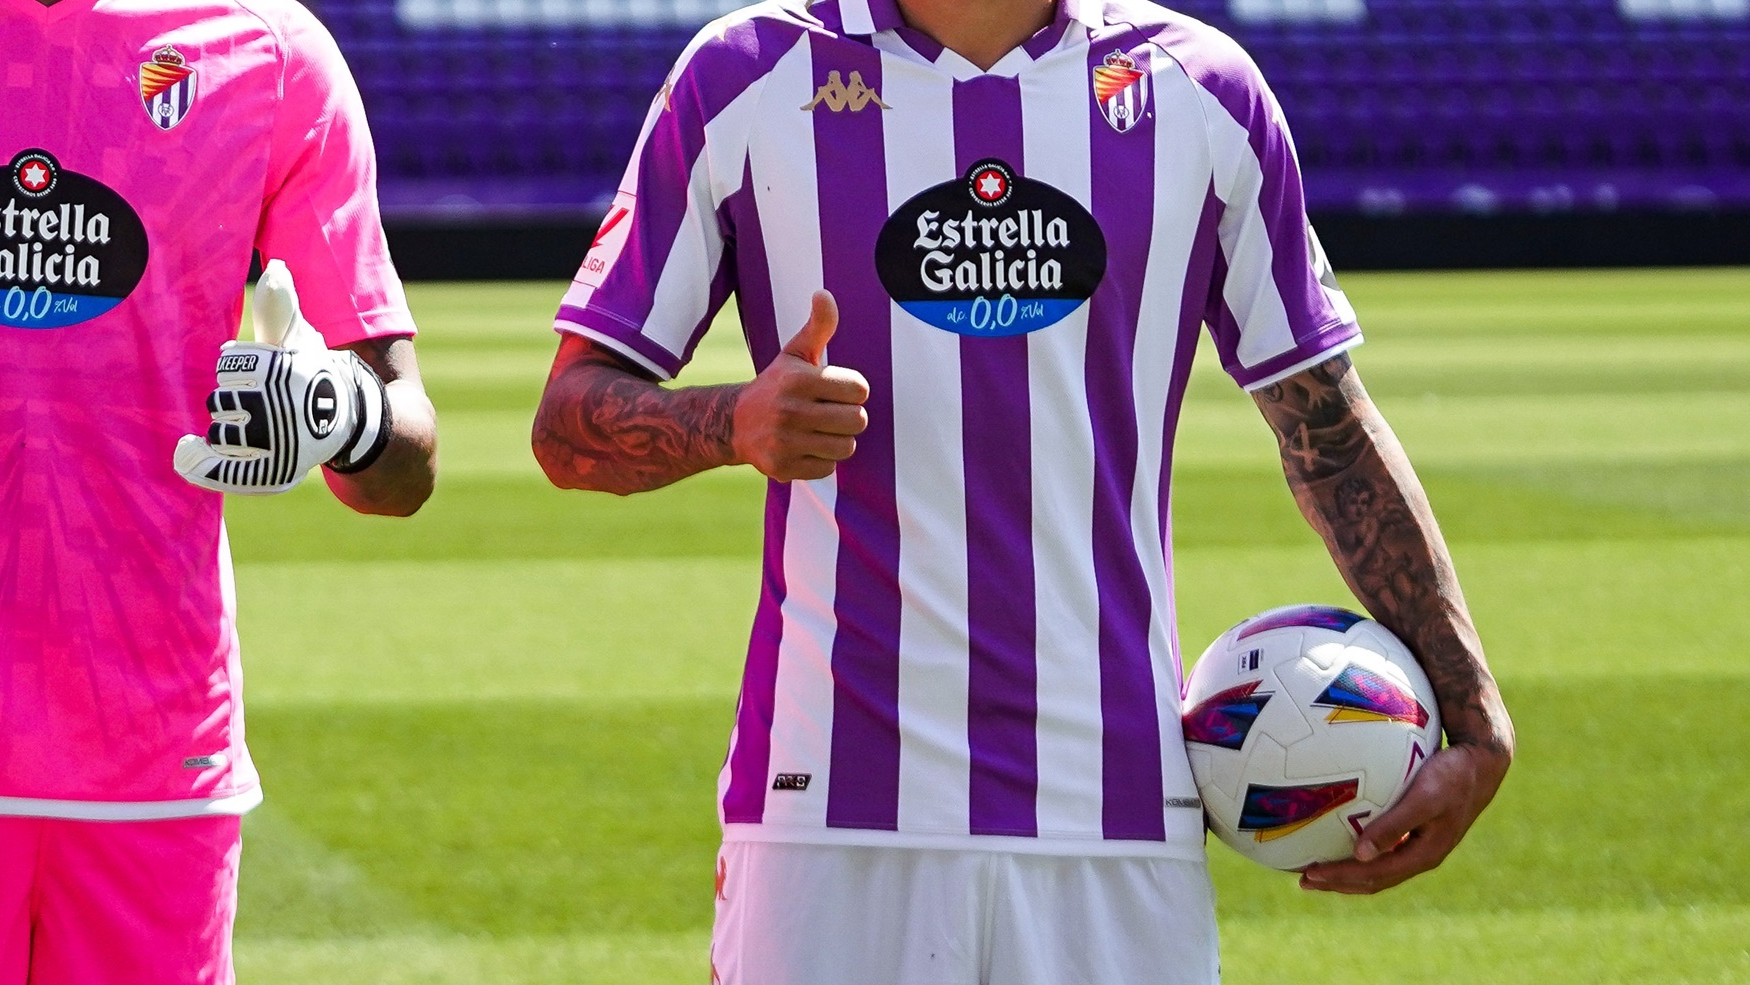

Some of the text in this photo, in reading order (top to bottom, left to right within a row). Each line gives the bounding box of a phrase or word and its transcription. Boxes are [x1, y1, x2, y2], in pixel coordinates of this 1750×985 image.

[913, 210, 1070, 249] Estrella
[920, 249, 1063, 291] Galicia
[4, 286, 52, 321] 0,0
[970, 293, 1017, 330] 0,0
